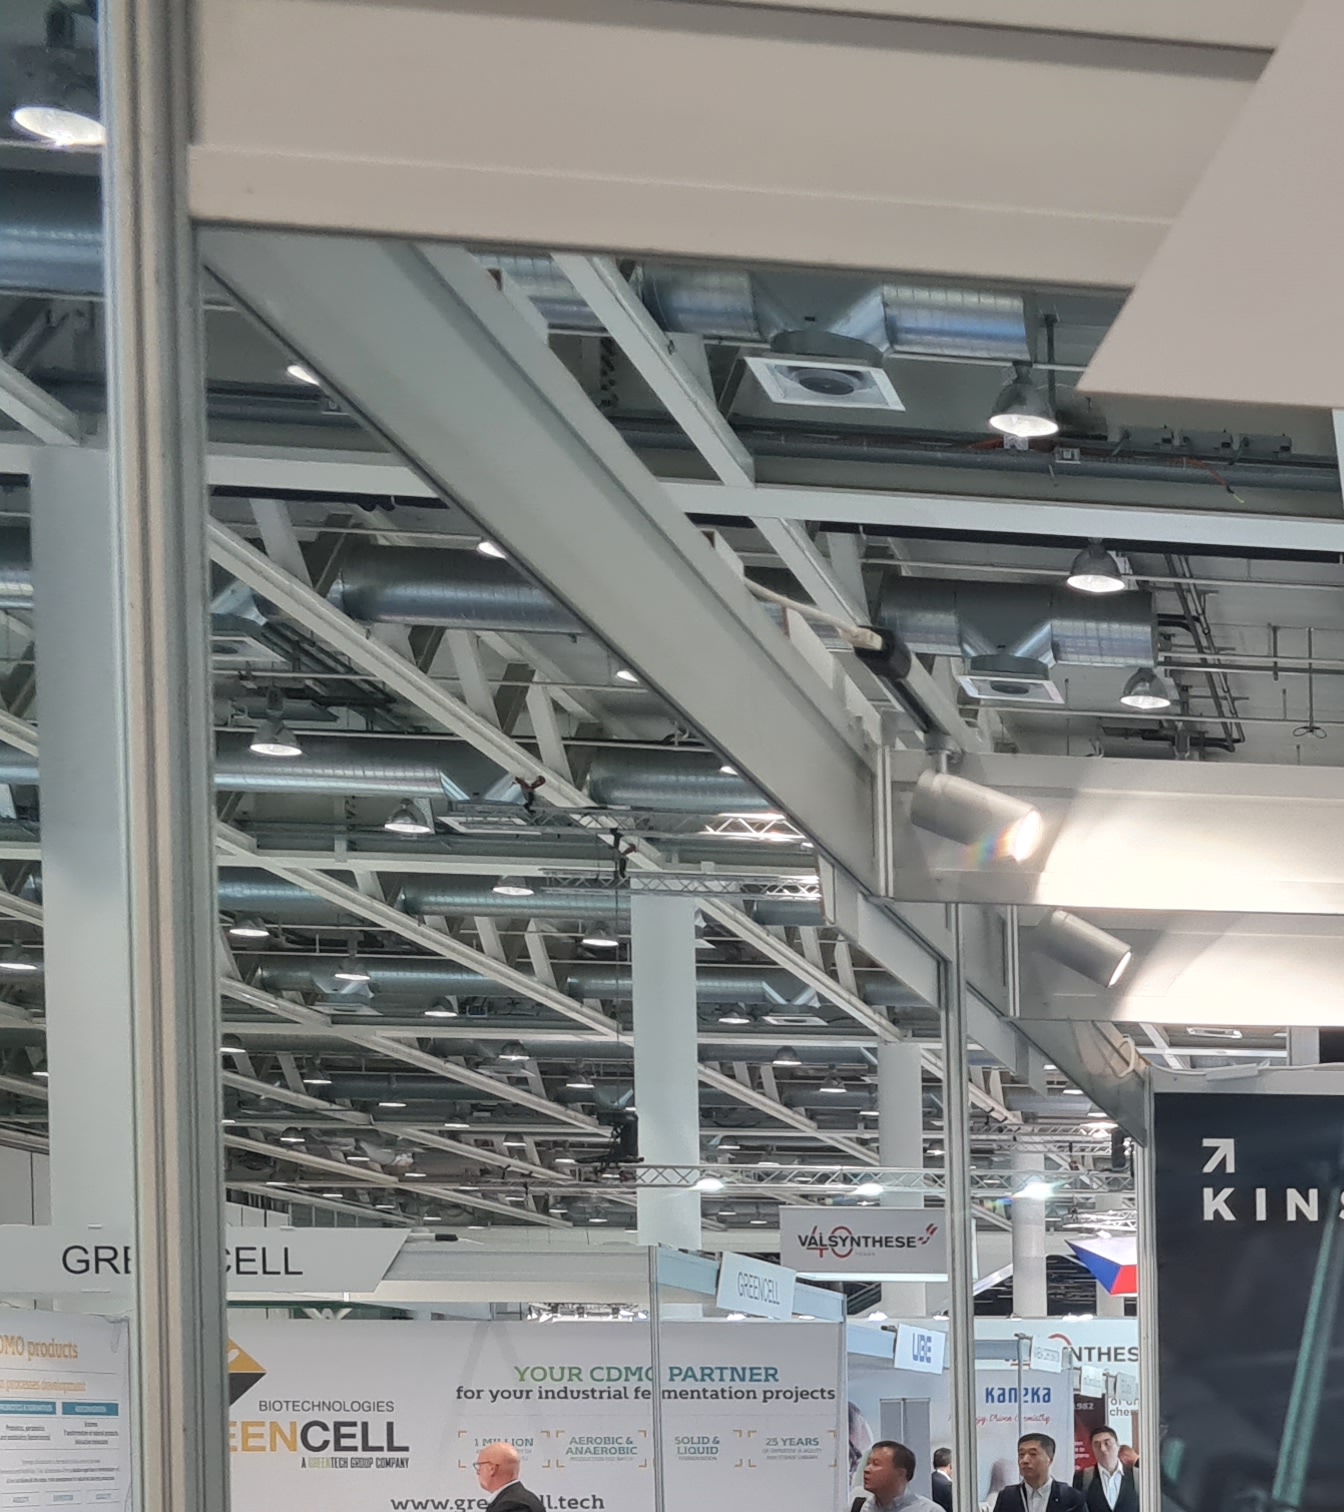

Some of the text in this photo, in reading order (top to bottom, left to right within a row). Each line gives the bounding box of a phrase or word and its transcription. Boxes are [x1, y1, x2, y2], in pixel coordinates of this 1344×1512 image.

[513, 1366, 583, 1383] YOUR
[668, 1366, 779, 1382] PARTNER
[456, 1386, 836, 1403] for your industrial fementation projects
[258, 1400, 395, 1412] BIOTECHNOLOGIES
[569, 1436, 622, 1445] AEROBIC
[674, 1436, 710, 1445] SOLID
[780, 1437, 820, 1446] YEARS
[565, 1446, 638, 1455] ANAEROBIC
[677, 1446, 719, 1455] LIQUID
[350, 1457, 373, 1469] GROUP
[375, 1457, 410, 1469] COMPANY
